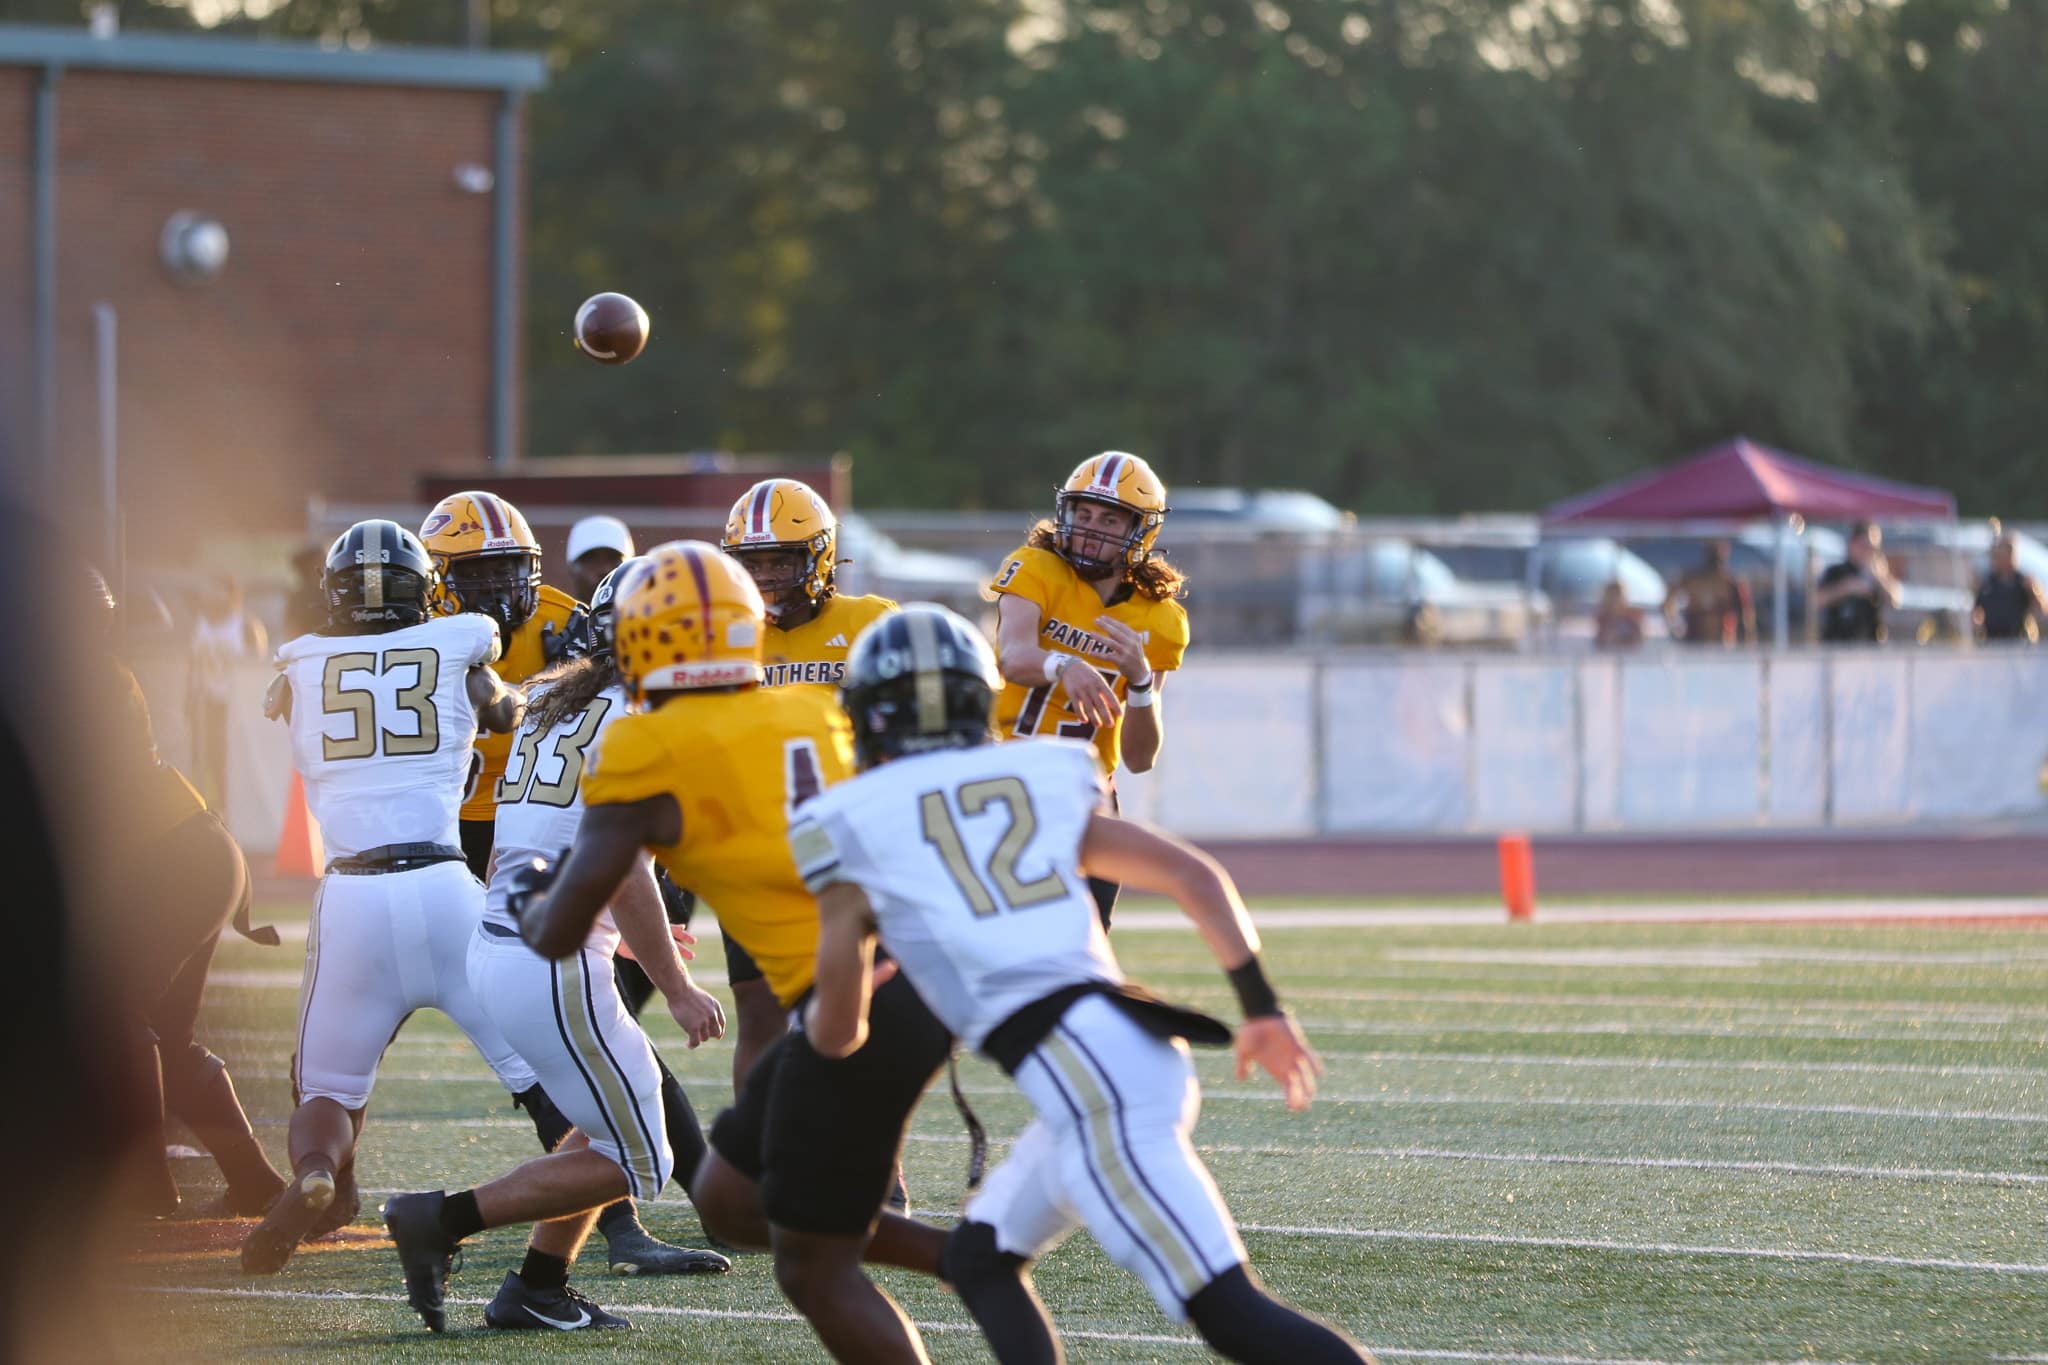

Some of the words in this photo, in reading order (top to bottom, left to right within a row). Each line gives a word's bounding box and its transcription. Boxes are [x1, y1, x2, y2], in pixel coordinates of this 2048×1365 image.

[487, 540, 515, 548] Riddell
[744, 534, 770, 542] Riddell
[355, 550, 390, 564] 53
[759, 661, 847, 688] NTHERS
[321, 647, 440, 762] 53
[501, 696, 613, 808] 33
[919, 776, 1071, 919] 12
